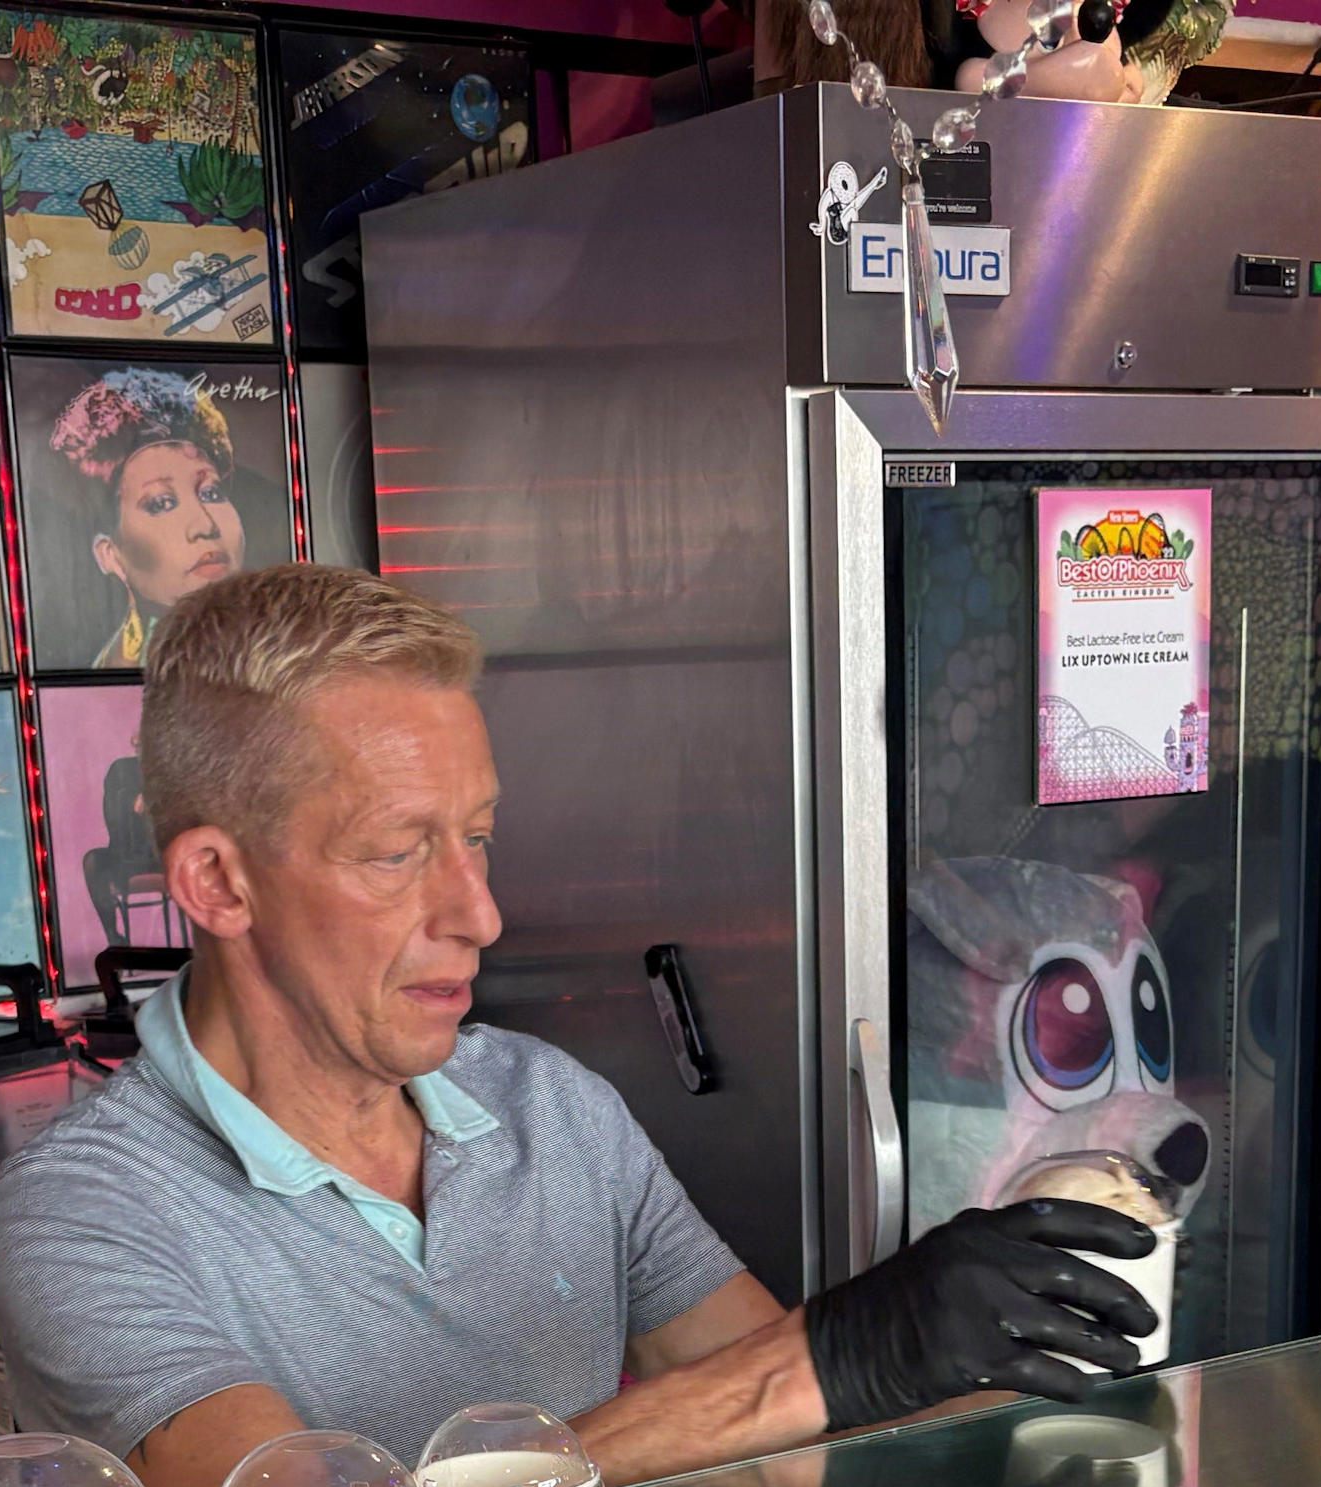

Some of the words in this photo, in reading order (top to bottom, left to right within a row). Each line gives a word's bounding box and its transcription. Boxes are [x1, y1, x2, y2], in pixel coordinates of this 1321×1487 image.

[182, 372, 279, 401] Aretha
[889, 466, 951, 483] FREEZER
[1066, 634, 1086, 648] Best
[1142, 631, 1156, 645] Ice
[1157, 630, 1185, 644] Cream
[1062, 655, 1079, 668] LIX
[1081, 652, 1131, 667] UPTOWN
[1133, 652, 1150, 665] ICE
[1152, 651, 1189, 663] CREAM
